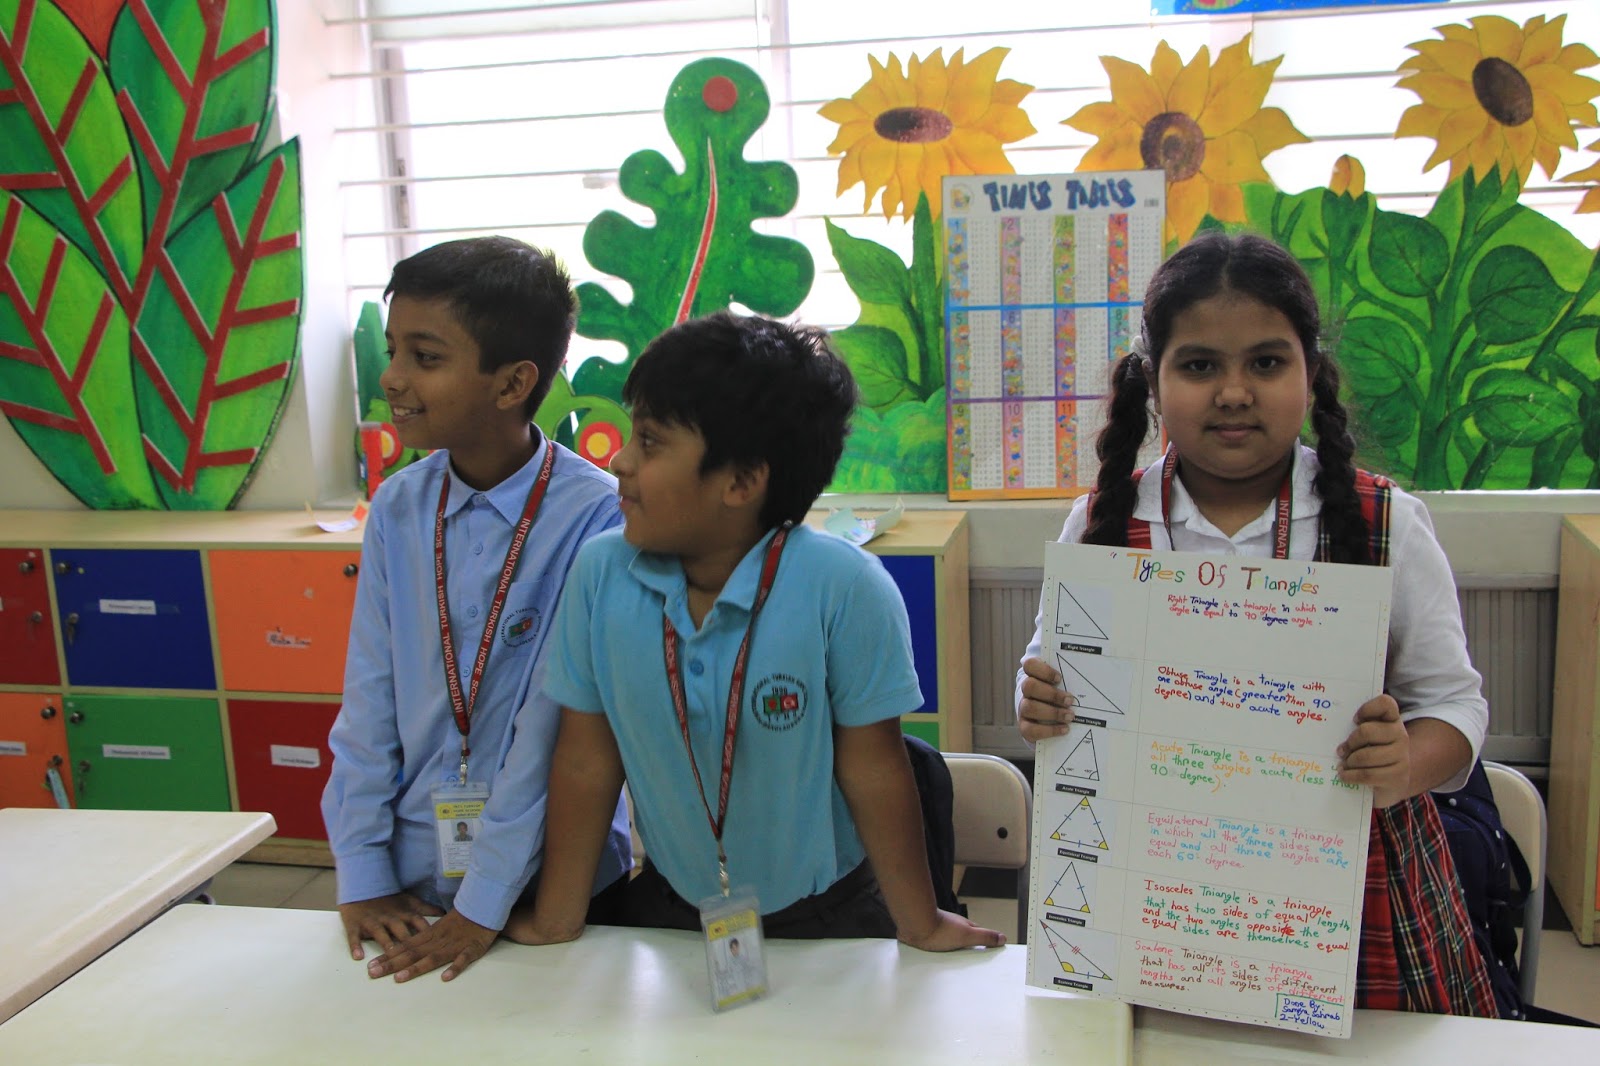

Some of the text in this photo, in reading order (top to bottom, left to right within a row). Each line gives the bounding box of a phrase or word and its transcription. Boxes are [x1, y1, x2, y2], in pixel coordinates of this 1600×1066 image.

[436, 553, 444, 580] HOPE
[498, 518, 531, 595] INTERNATIONAL
[1198, 561, 1227, 588] Of
[437, 584, 450, 629] TURKISH
[1168, 594, 1187, 607] Right
[1190, 596, 1218, 611] Triangle
[1224, 600, 1230, 609] is
[1244, 599, 1277, 616] triangle
[1282, 604, 1290, 613] in
[1295, 602, 1317, 613] which
[1169, 605, 1189, 616] angle
[1192, 606, 1200, 614] is
[1203, 608, 1224, 619] equal
[1229, 609, 1238, 618] to
[1245, 611, 1257, 620] 90
[1262, 614, 1289, 627] degree
[484, 600, 502, 643] TURKISH
[443, 632, 464, 713] INTERNATIONAL
[474, 648, 488, 676] HOPE
[1157, 676, 1170, 684] one
[1174, 678, 1203, 690] obtuse
[1313, 698, 1331, 709] 90
[1158, 666, 1188, 679] Obtuse
[1194, 670, 1228, 686] Triangle
[1233, 676, 1241, 685] is
[1259, 673, 1295, 692] triangle
[1302, 682, 1325, 693] with
[1154, 684, 1192, 700] degree)
[1195, 695, 1215, 705] and
[1220, 697, 1241, 709] two
[1249, 704, 1280, 716] acute
[1151, 752, 1166, 763] all
[1172, 754, 1204, 769] three
[1212, 762, 1252, 778] angles
[1260, 766, 1293, 779] acute
[1151, 763, 1168, 776] 90
[1152, 741, 1183, 754] Acute
[1187, 743, 1232, 763] Triangle
[1255, 755, 1265, 763] a
[1269, 751, 1323, 776] triangle
[1074, 787, 1090, 795] Triangle
[1148, 812, 1344, 848] Equilateral Triangle is a triangle
[1151, 825, 1343, 858] in which all the three sides are
[1081, 853, 1096, 861] Triangle
[1147, 848, 1171, 859] each
[1149, 838, 1348, 869] equal and all three angles are
[1144, 879, 1193, 895] Isosceles
[1198, 885, 1240, 904] Triangle
[1248, 893, 1258, 905] is
[1283, 897, 1332, 919] triangle
[1144, 895, 1350, 933] that has two sides of equal length
[1142, 908, 1160, 917] and
[1166, 910, 1181, 921] the
[1185, 914, 1203, 925] two
[1210, 918, 1240, 930] angles
[1300, 926, 1319, 938] the
[1142, 917, 1350, 953] equal sides are themselves equal
[1140, 955, 1337, 994] that has all its sides of different
[1181, 947, 1223, 967] Triangle
[1230, 956, 1240, 968] is
[1249, 963, 1259, 971] a
[1268, 963, 1313, 980] triangle
[1140, 967, 1345, 1003] lengths and all angles of different
[1284, 998, 1306, 1008] Done
